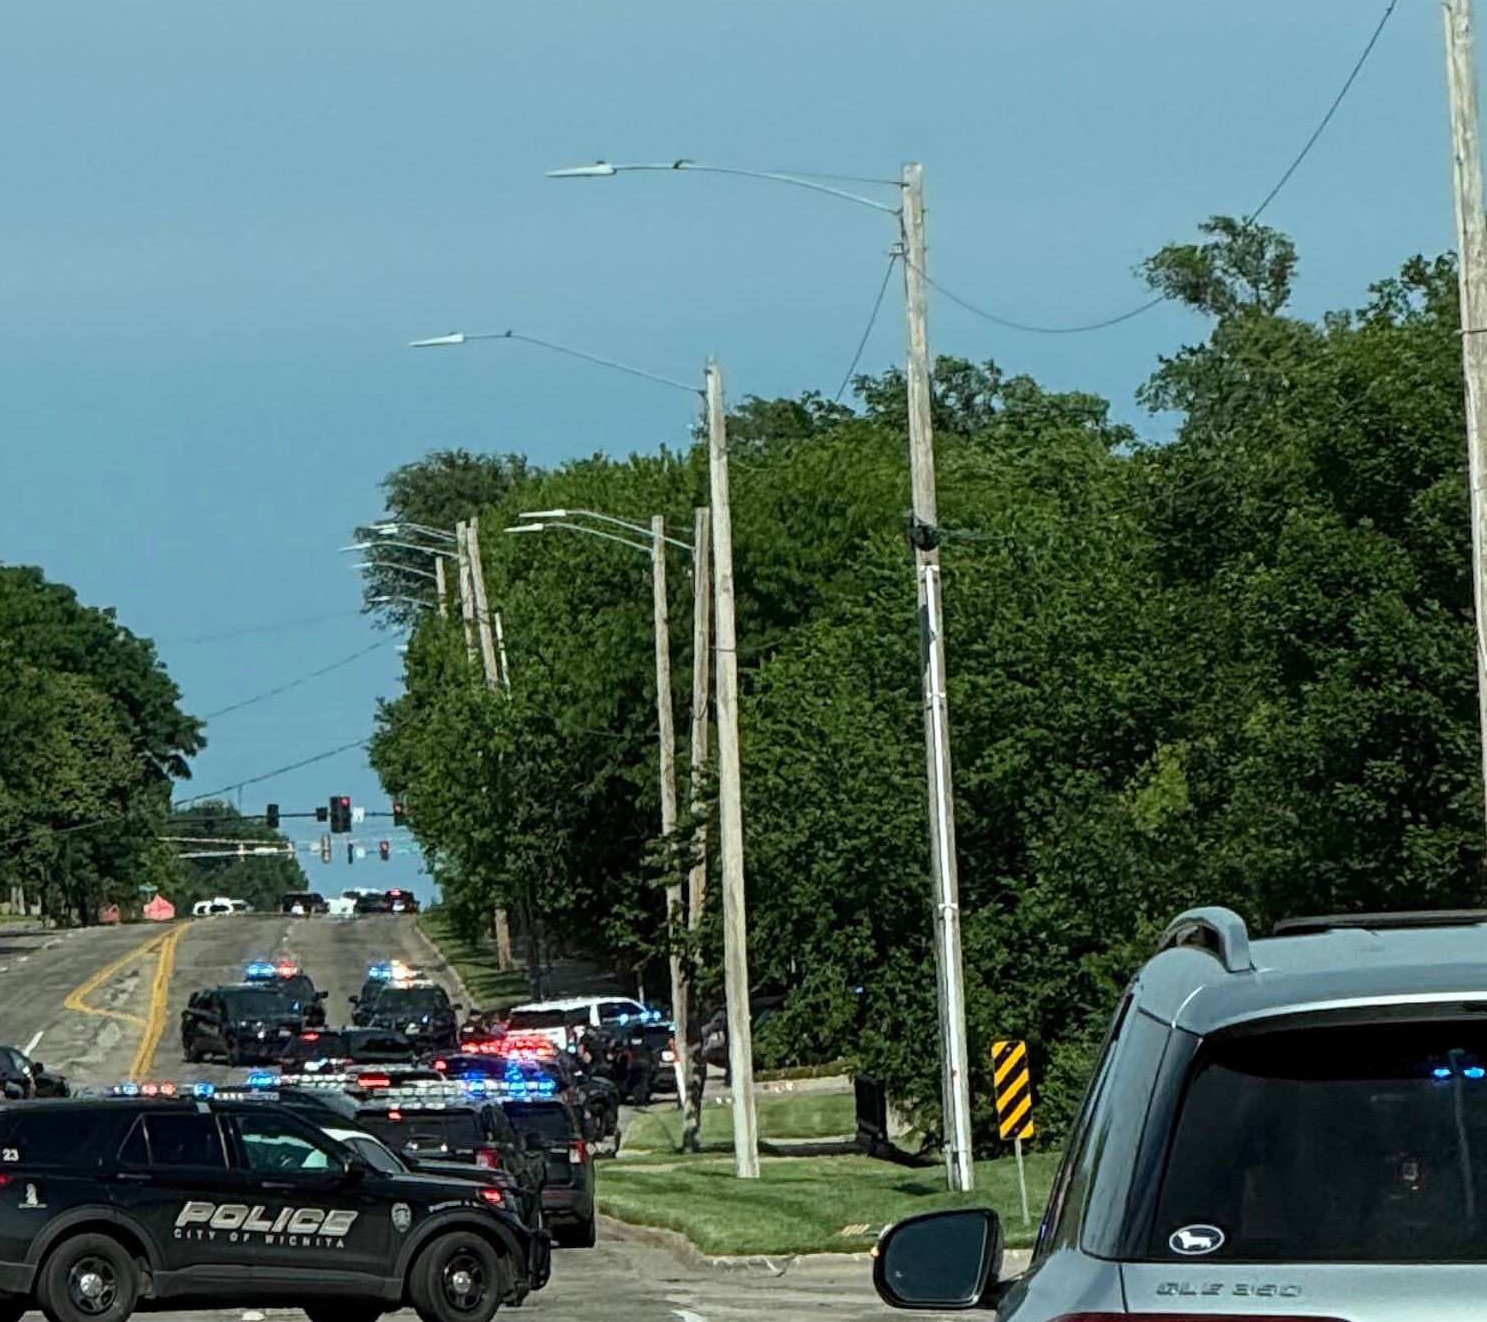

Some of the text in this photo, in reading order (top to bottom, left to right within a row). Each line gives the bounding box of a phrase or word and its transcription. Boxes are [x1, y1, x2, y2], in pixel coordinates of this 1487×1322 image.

[2, 1148, 19, 1161] 23
[174, 1201, 359, 1237] POLICE
[174, 1229, 344, 1248] CITY OF WICHITA
[1156, 1282, 1224, 1296] GLE
